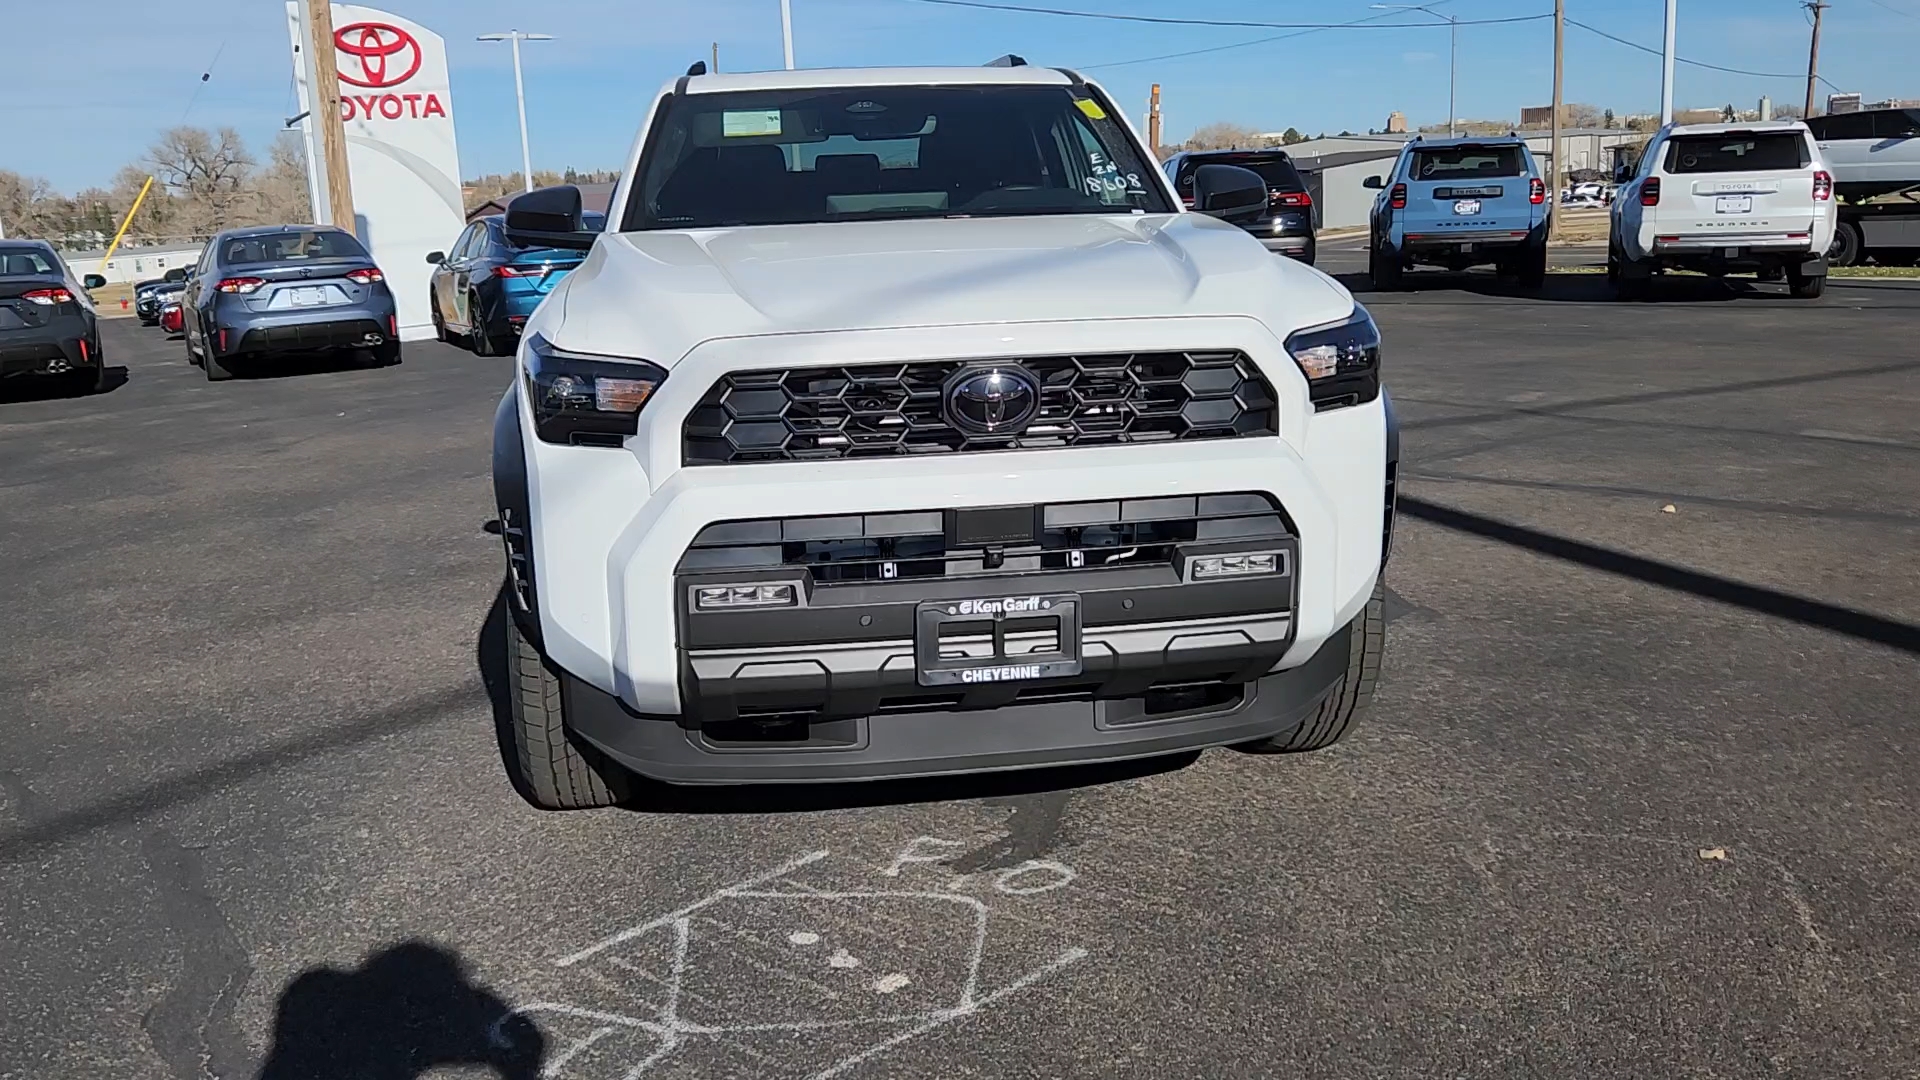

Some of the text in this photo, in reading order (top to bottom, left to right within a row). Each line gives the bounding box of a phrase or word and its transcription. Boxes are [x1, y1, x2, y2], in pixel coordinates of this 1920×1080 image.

[340, 94, 446, 122] OYOTA
[1086, 173, 1142, 193] 8608
[973, 596, 1040, 614] Ken Garff
[962, 665, 1040, 683] CHEYENNE
